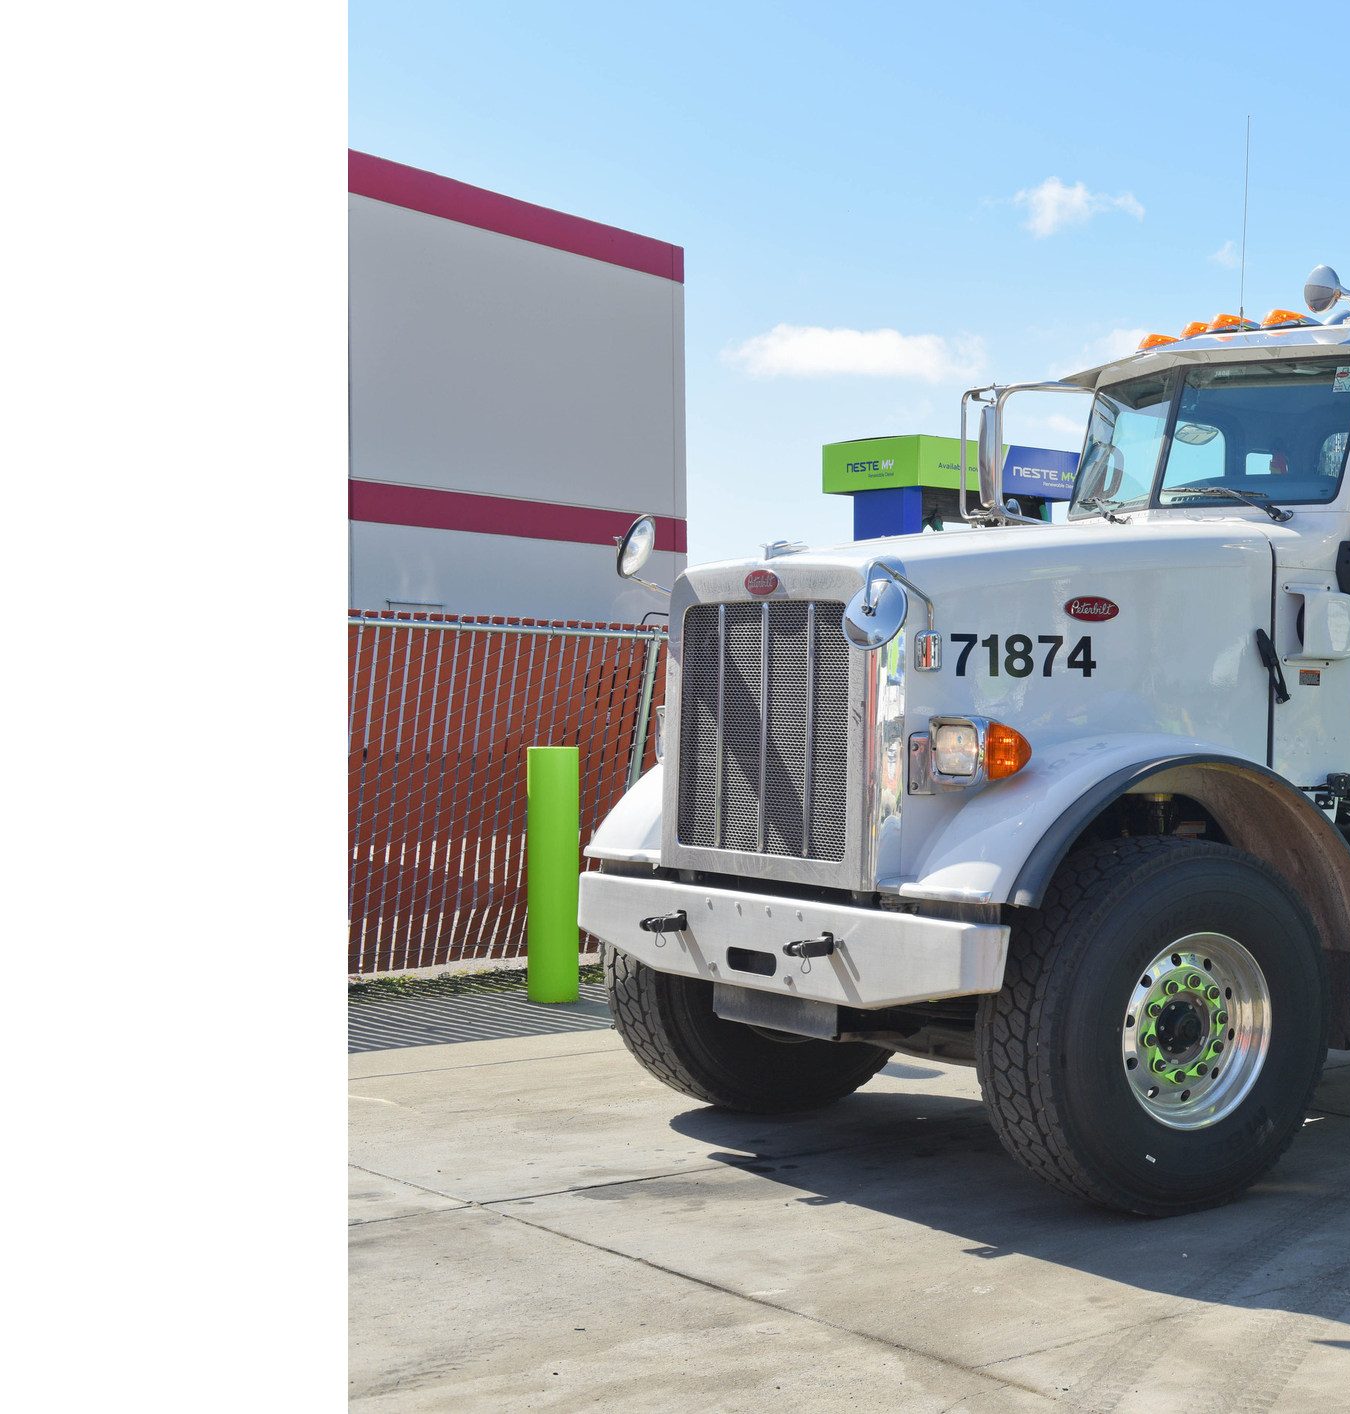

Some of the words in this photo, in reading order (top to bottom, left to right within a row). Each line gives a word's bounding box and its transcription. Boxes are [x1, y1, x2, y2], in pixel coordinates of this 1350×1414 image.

[846, 460, 880, 473] NESTE
[881, 459, 895, 470] MY
[937, 462, 961, 471] Availab
[1012, 465, 1059, 481] NESTE
[1071, 599, 1116, 615] Peterbilt
[950, 633, 1097, 678] 71874
